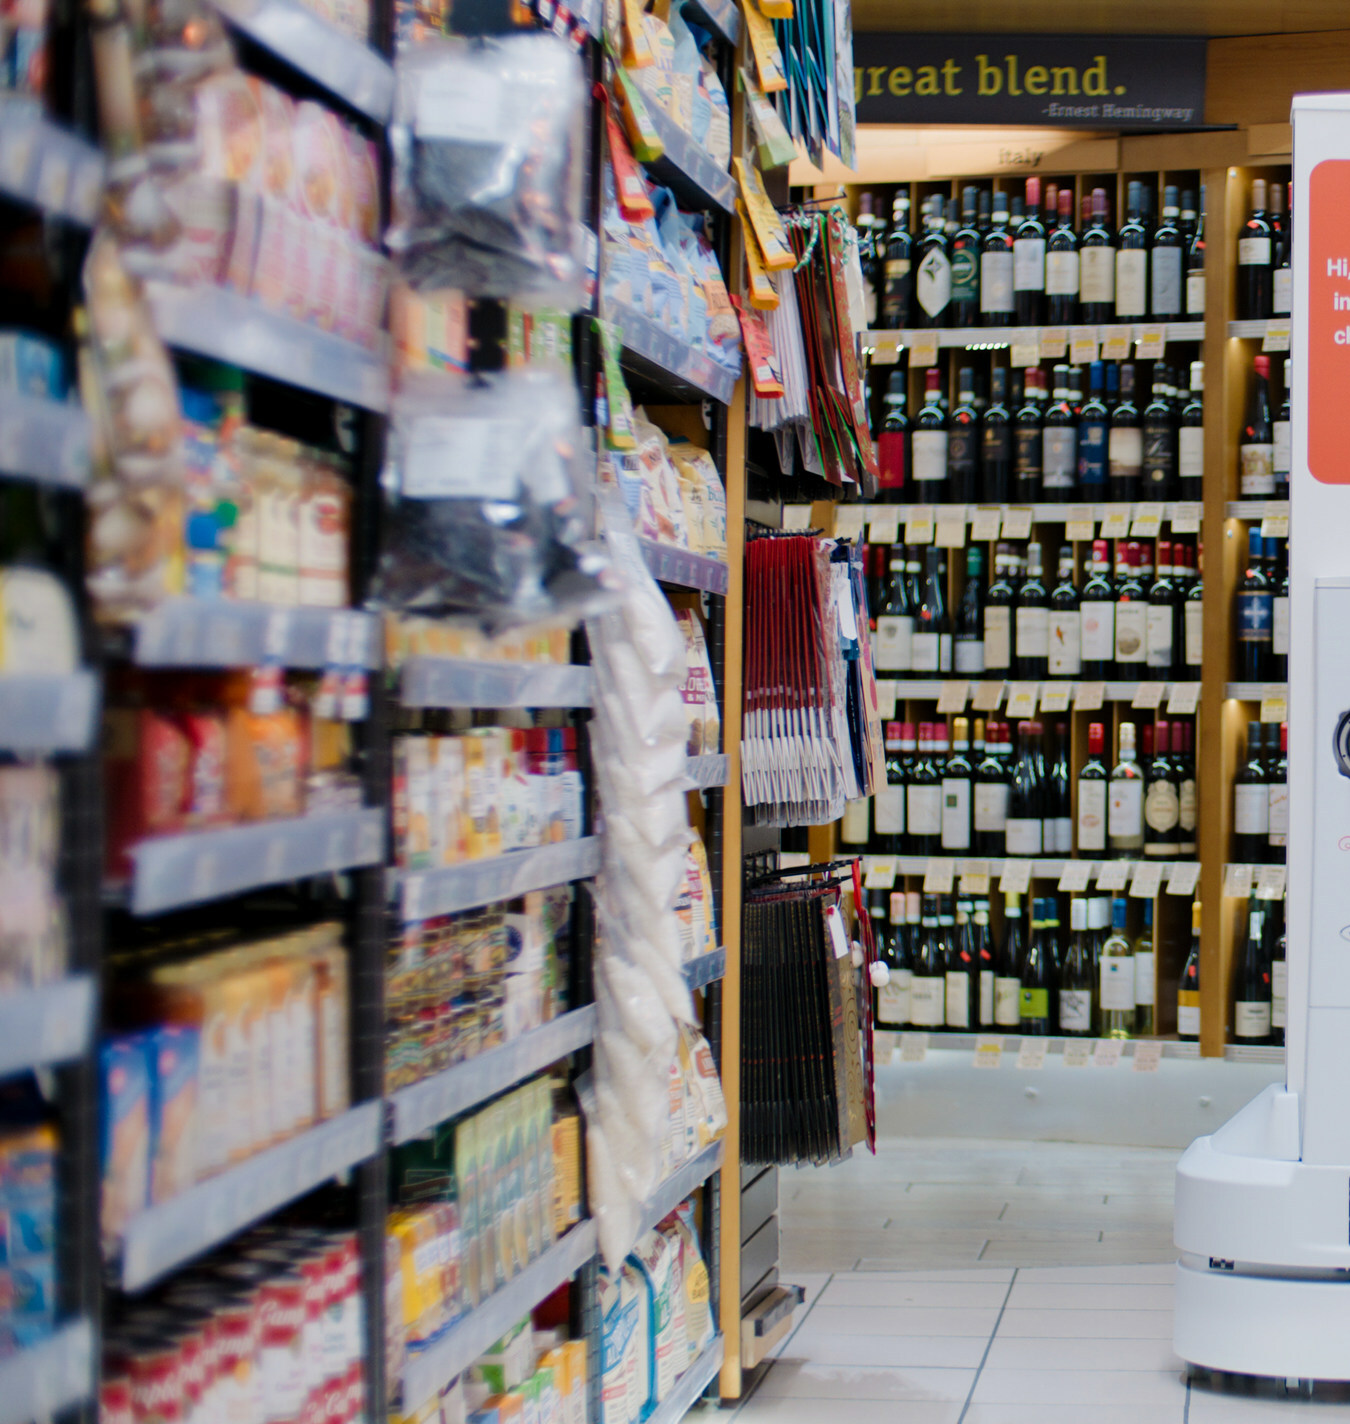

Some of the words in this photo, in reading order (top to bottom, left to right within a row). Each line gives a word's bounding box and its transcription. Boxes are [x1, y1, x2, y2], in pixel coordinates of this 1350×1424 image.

[976, 54, 1127, 96] blend.
[1042, 103, 1099, 118] -Ernest
[1102, 104, 1195, 121] Hemingway
